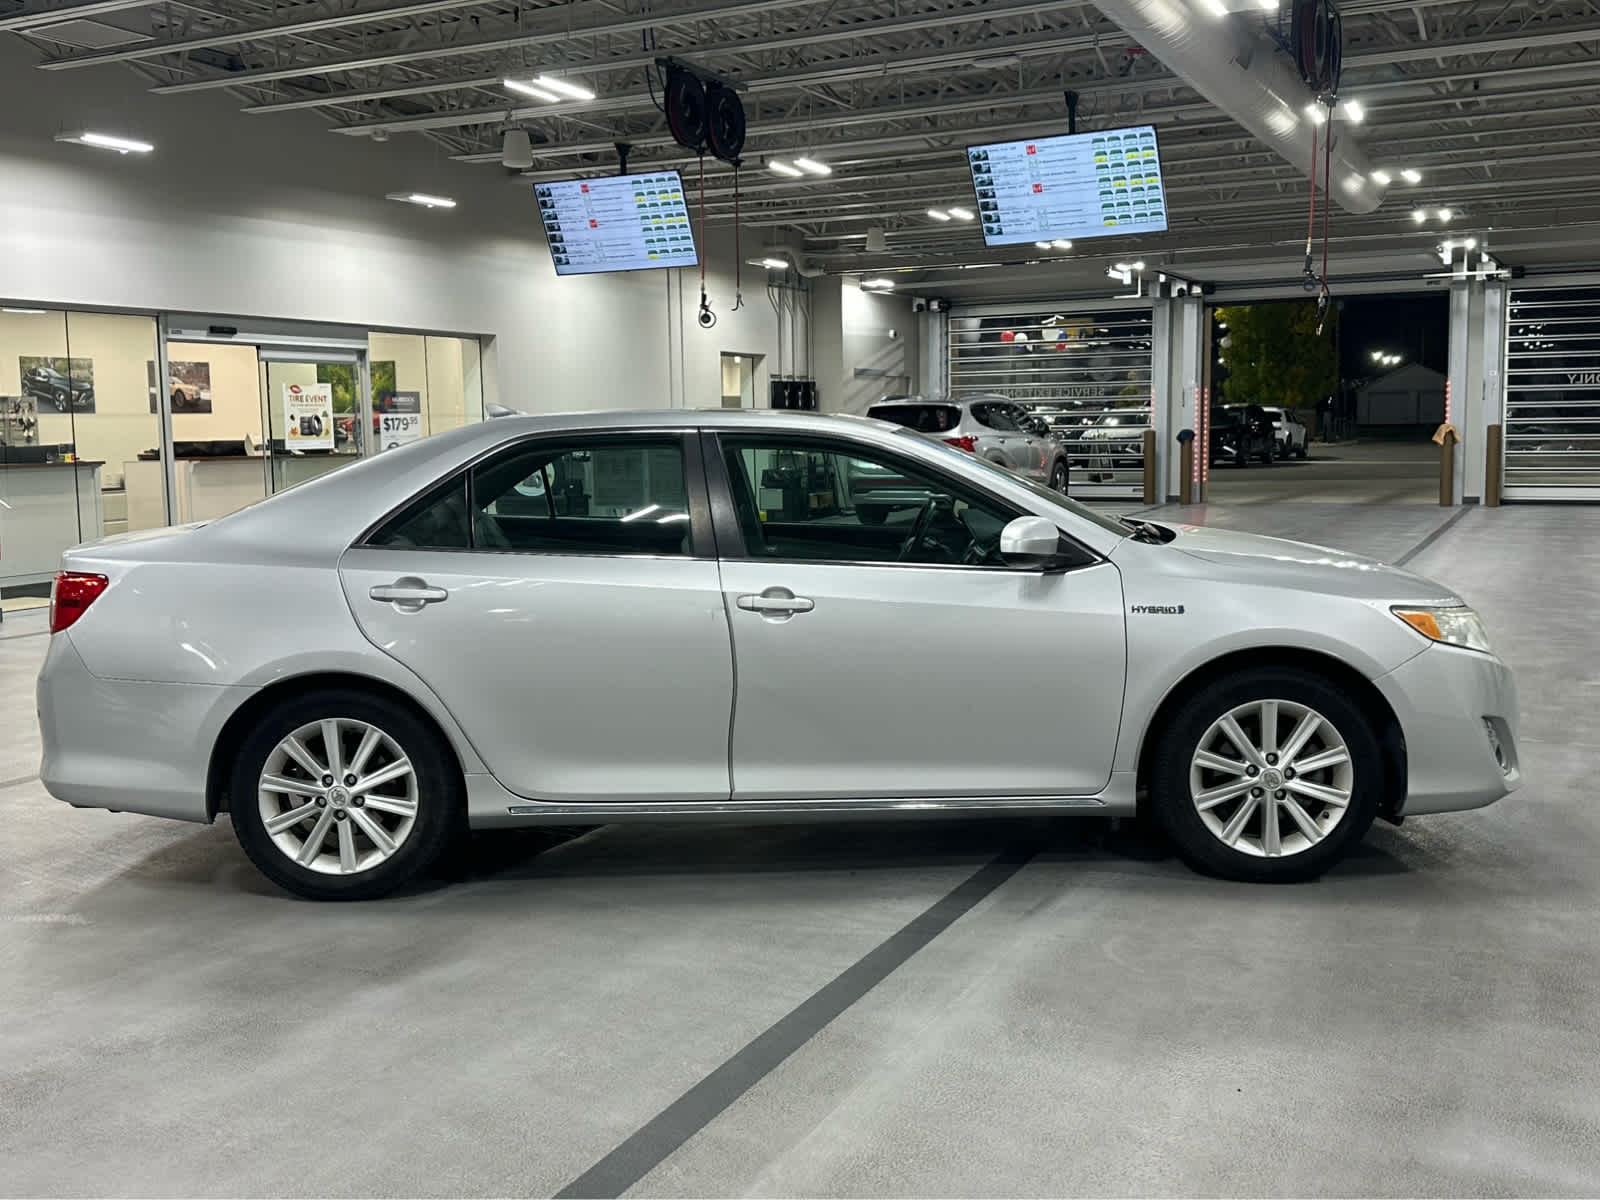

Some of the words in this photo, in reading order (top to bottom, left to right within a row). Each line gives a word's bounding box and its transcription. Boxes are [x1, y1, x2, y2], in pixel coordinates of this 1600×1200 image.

[289, 394, 304, 403] TIRE
[305, 394, 327, 403] EVENT
[1131, 605, 1176, 614] HYBRID
